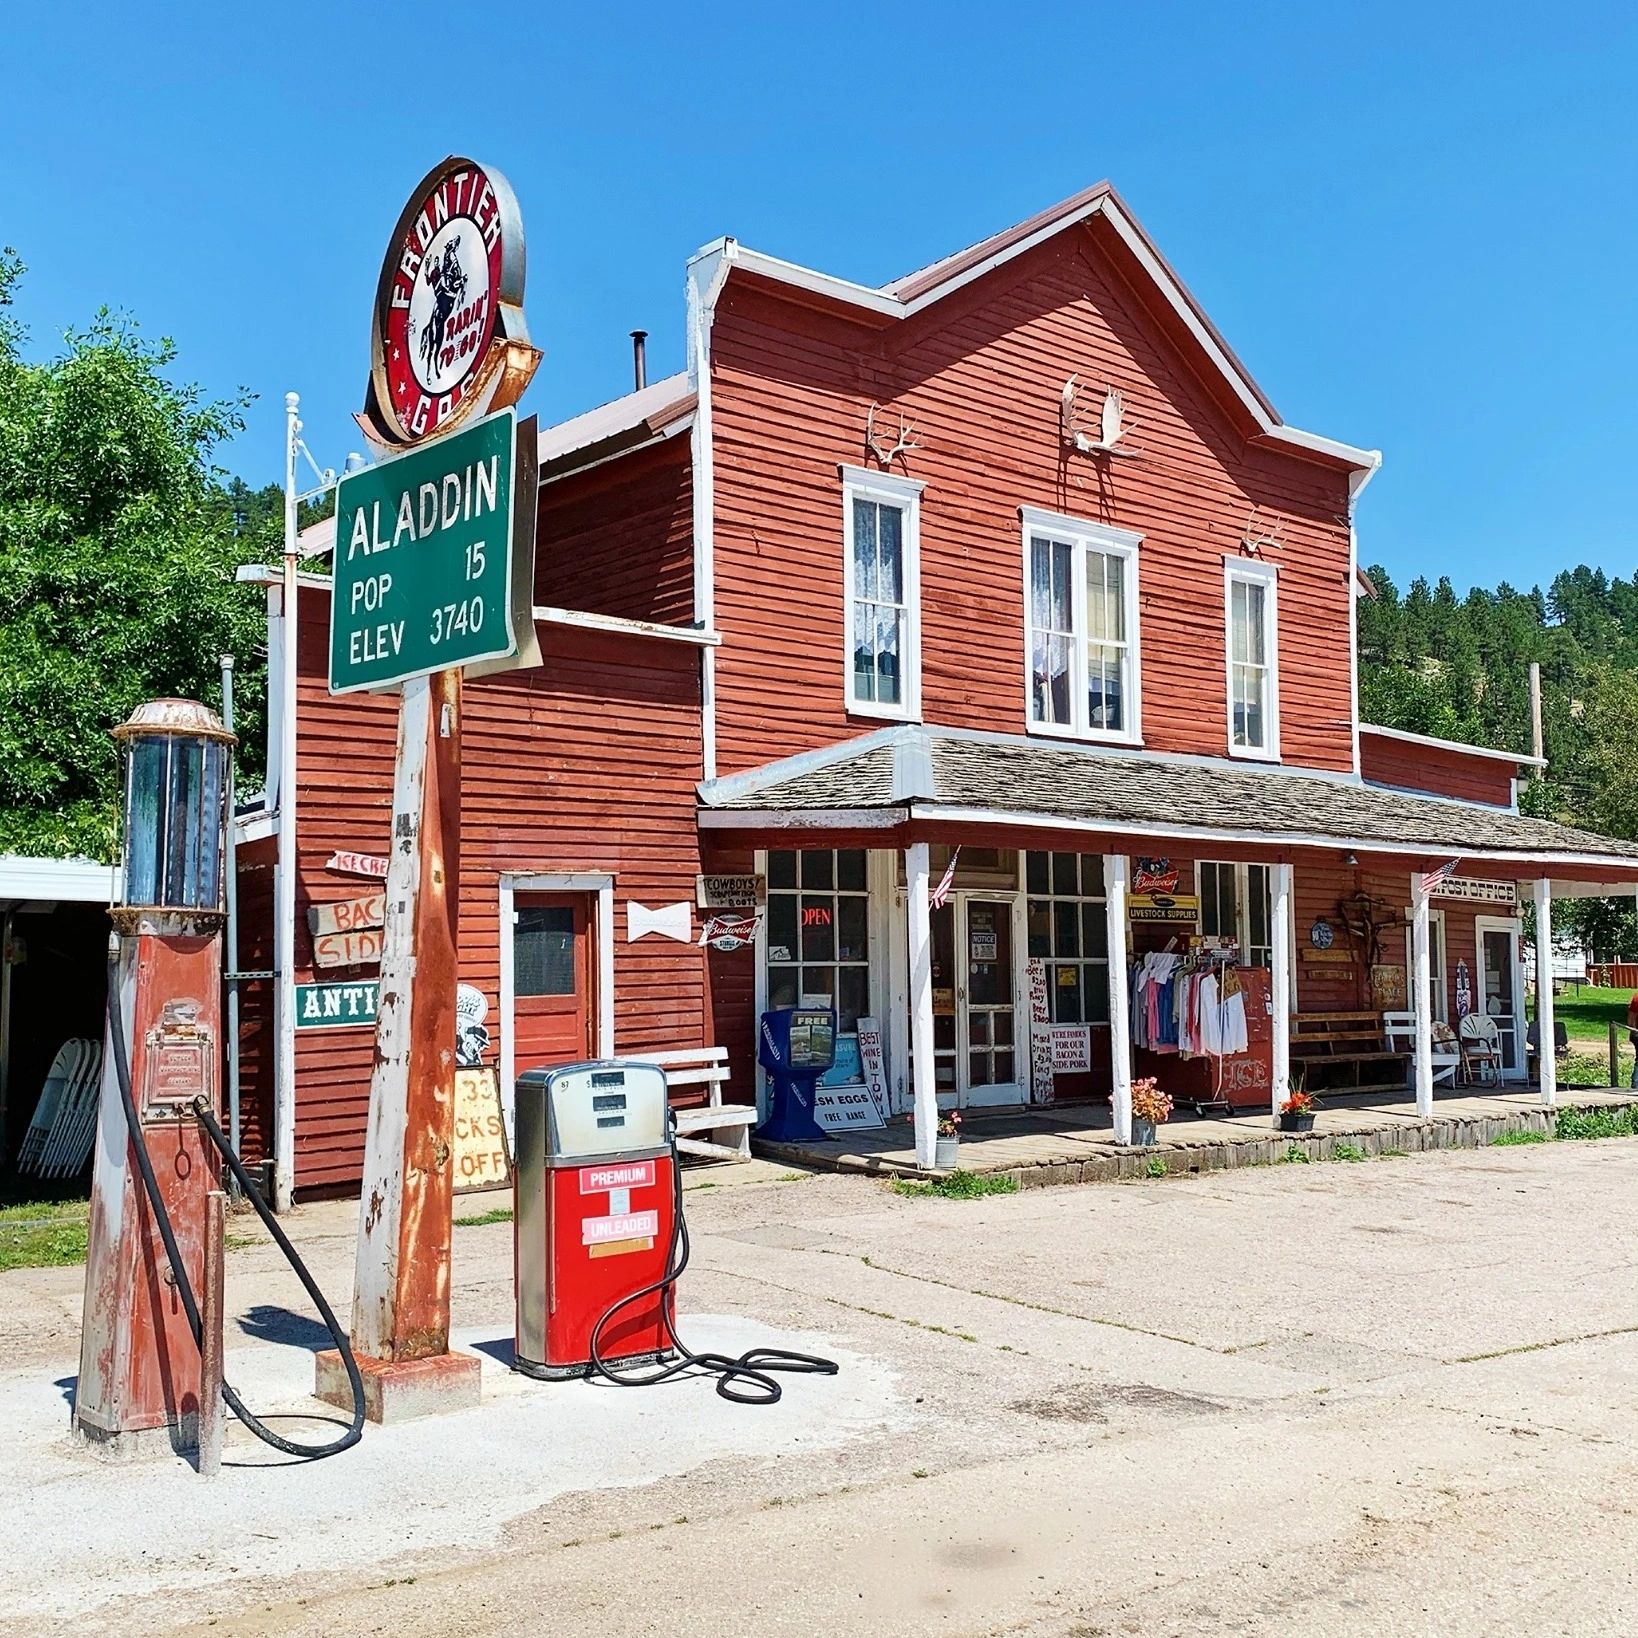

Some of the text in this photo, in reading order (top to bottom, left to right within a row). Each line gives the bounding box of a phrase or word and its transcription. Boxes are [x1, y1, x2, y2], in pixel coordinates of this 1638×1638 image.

[392, 171, 501, 309] FRONTIER
[446, 290, 488, 341] RARIN'
[440, 345, 455, 370] TO
[347, 454, 499, 561] ALADDIN
[351, 541, 486, 615] POP 15
[349, 596, 485, 665] ELEV 3740
[336, 854, 387, 874] ICE CRE
[1441, 879, 1514, 901] POST OFFICE
[333, 898, 385, 930] BAC
[801, 908, 831, 925] OPEN
[1130, 909, 1197, 919] LIVESTOCK SUPPLIES
[973, 935, 995, 943] NOTICE
[303, 987, 379, 1019] ANTI
[797, 1017, 828, 1025] FREE
[860, 1032, 880, 1046] BEST
[1055, 1041, 1085, 1049] FOR OUR
[861, 1048, 881, 1057] WINE
[1055, 1050, 1084, 1059] BACON &
[869, 1060, 878, 1070] IN
[1052, 1060, 1088, 1069] SIDE PORK
[1229, 1060, 1269, 1089] ICE
[837, 1094, 869, 1105] EGGS
[824, 1110, 867, 1122] FREE RANGE
[455, 1115, 501, 1139] CKS
[460, 1151, 503, 1177] OFF
[590, 1167, 646, 1188] PREMIUM
[590, 1216, 651, 1238] UNLEADED
